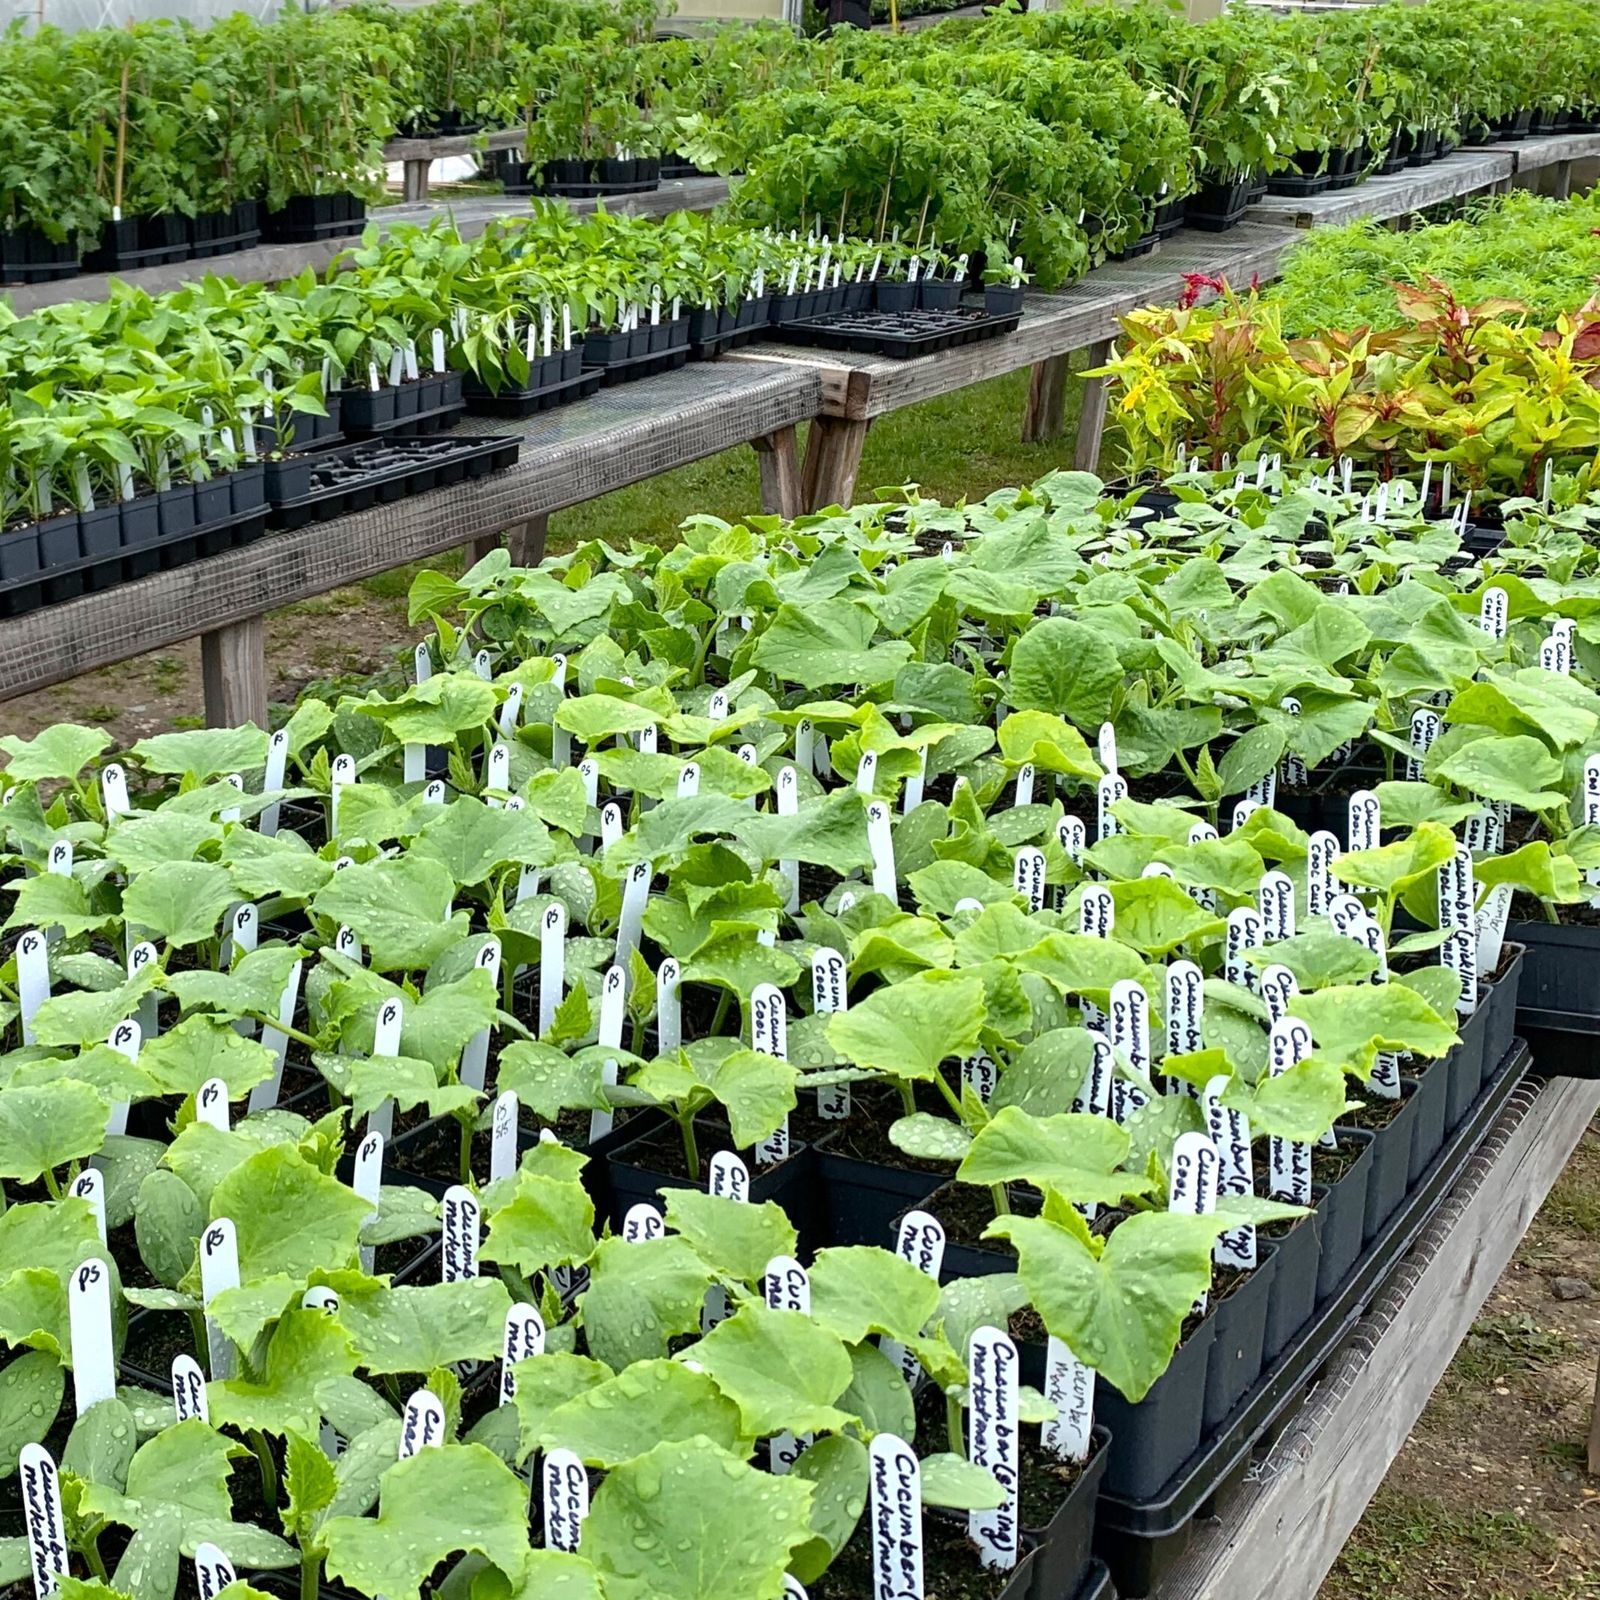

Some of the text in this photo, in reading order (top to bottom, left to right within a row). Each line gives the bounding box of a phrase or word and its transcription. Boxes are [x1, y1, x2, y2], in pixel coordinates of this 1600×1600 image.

[1364, 798, 1378, 849] Cucum
[828, 957, 842, 1014] Cucum
[1129, 990, 1147, 1070] Cucumb
[1089, 1042, 1111, 1115] Cucumb
[1195, 1148, 1216, 1214] Cucum
[444, 1199, 461, 1283] marketm
[460, 1199, 478, 1279] Cucumb
[993, 1342, 1015, 1462] Cucumber
[24, 1463, 49, 1600] marketmor
[548, 1462, 568, 1552] market
[566, 1464, 584, 1553] Cucum
[895, 1453, 919, 1590] Cucumber
